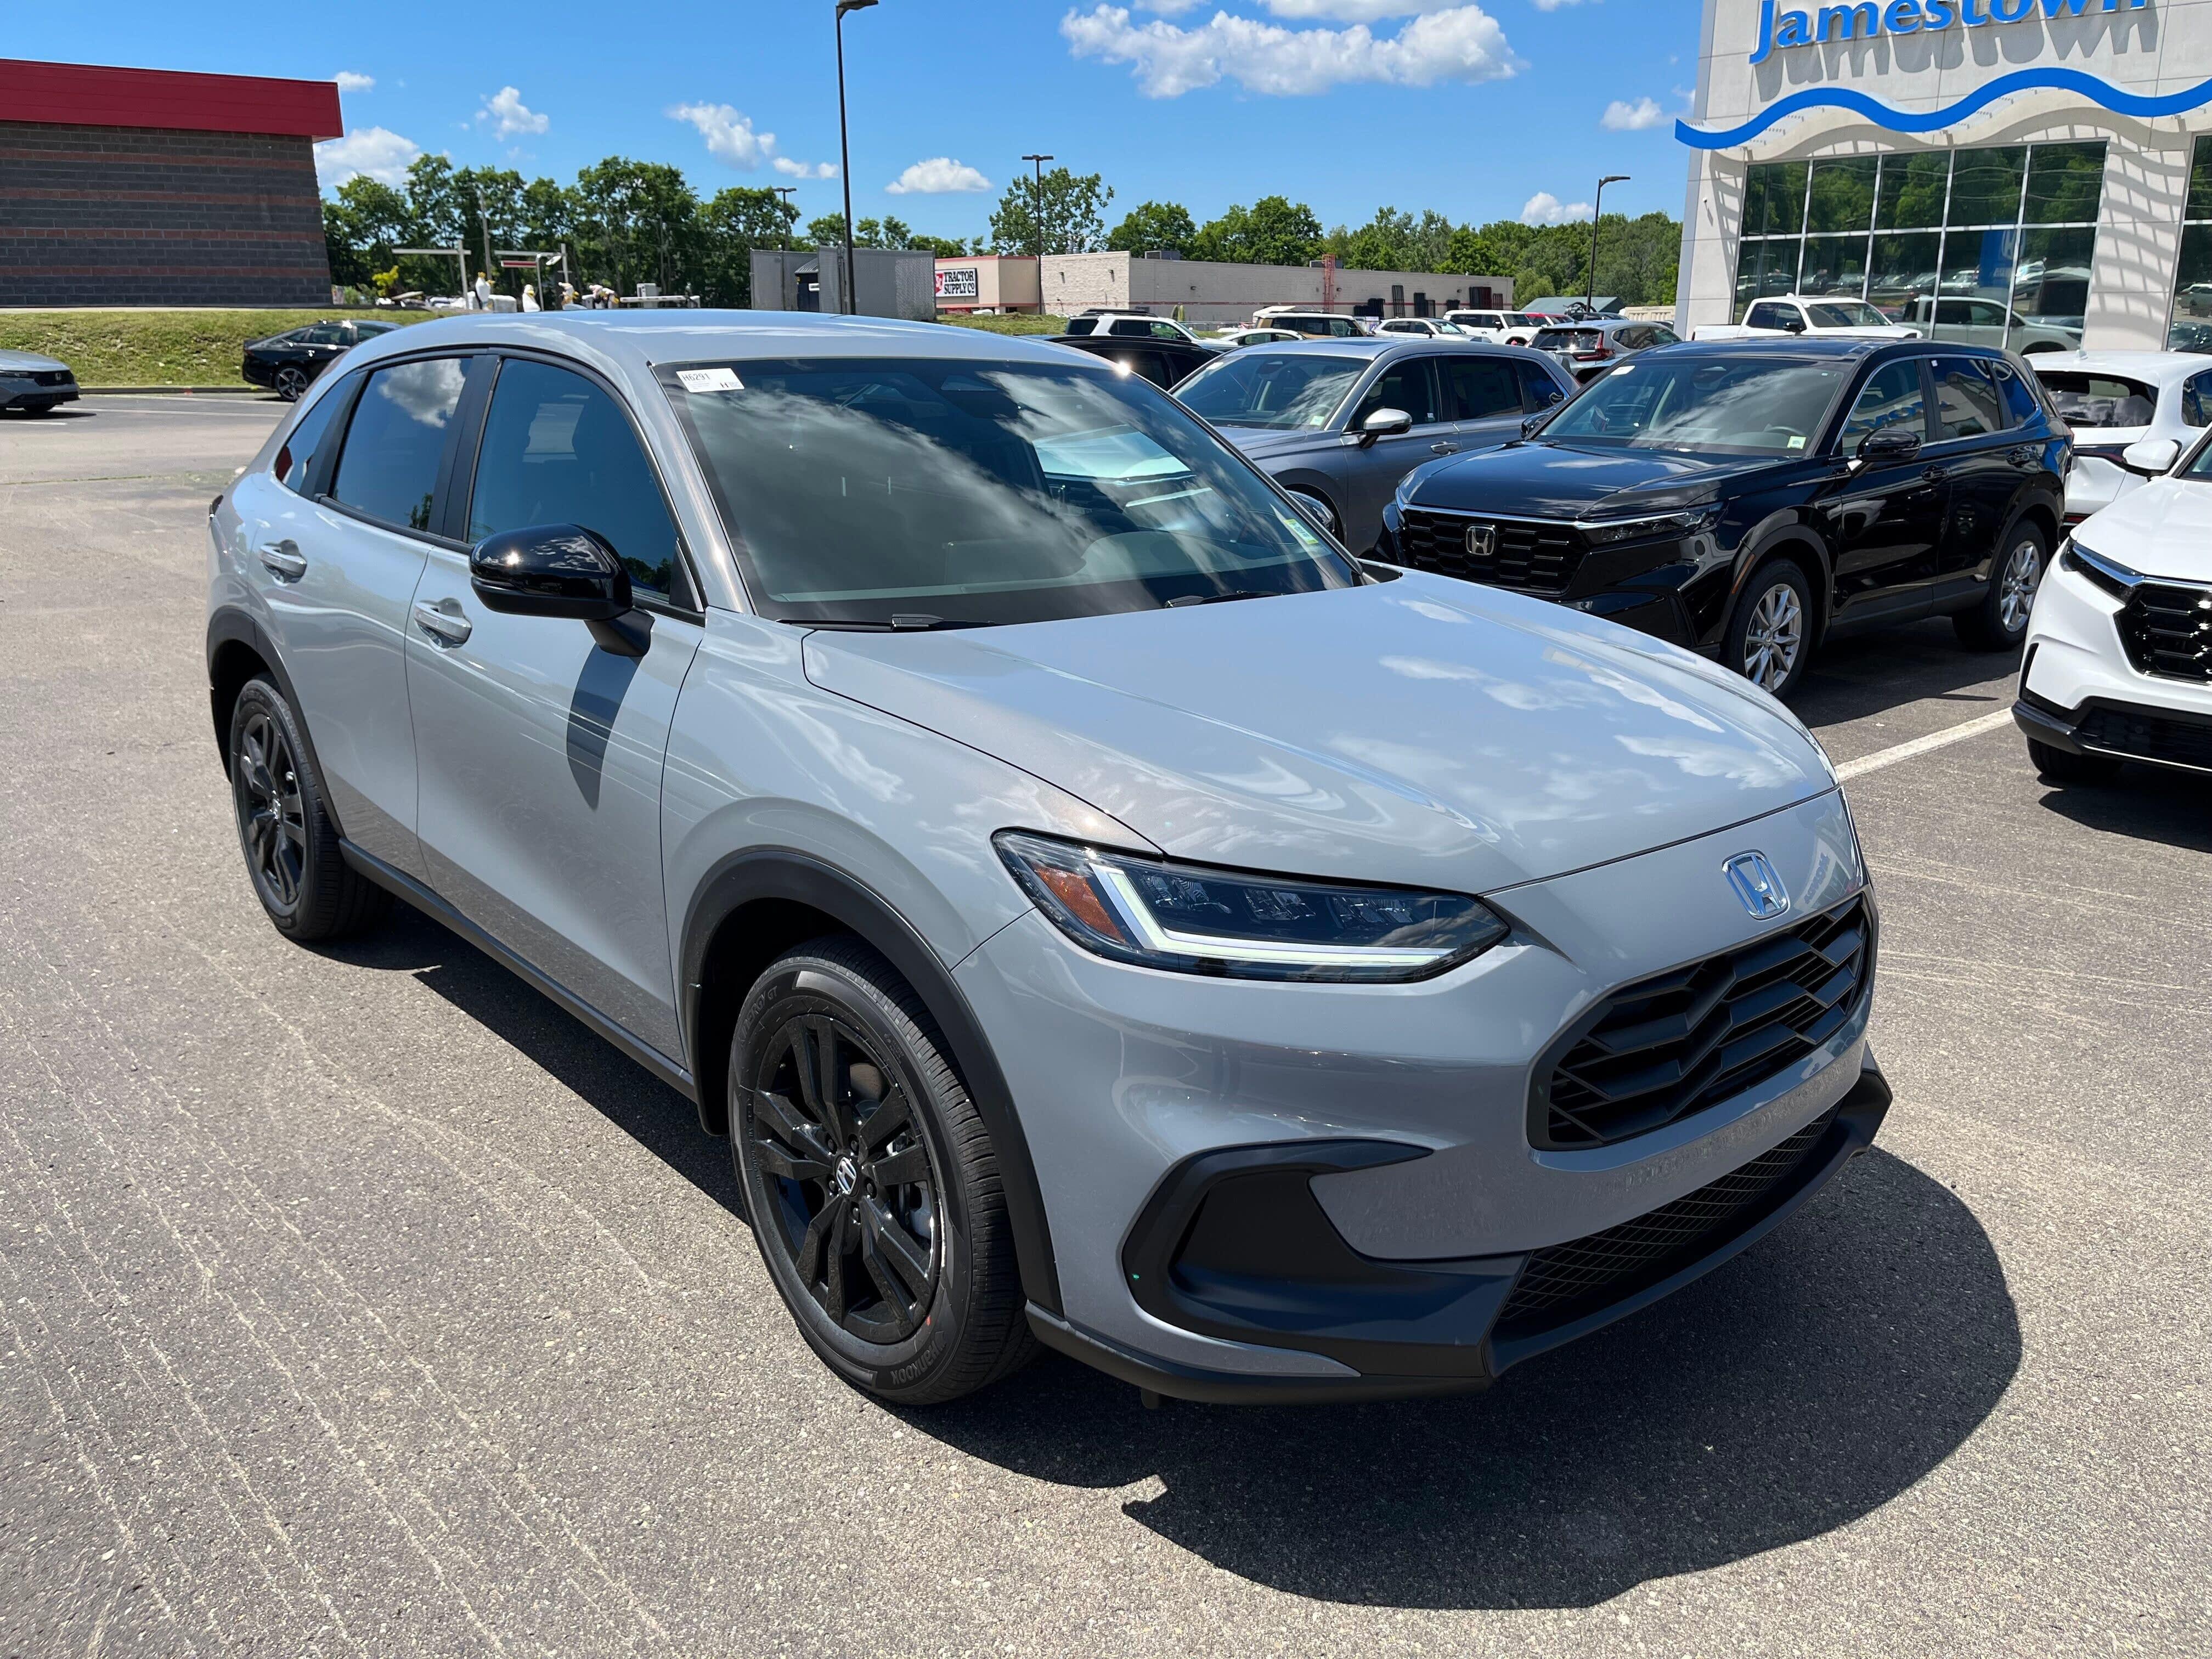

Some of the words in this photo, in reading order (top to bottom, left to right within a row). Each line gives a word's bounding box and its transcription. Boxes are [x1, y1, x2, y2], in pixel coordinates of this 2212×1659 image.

[1749, 0, 2146, 65] Jamestow
[944, 271, 974, 282] TRACTOR
[944, 283, 966, 294] SUPPLY
[682, 373, 710, 381] H6291
[768, 986, 777, 1000] GT
